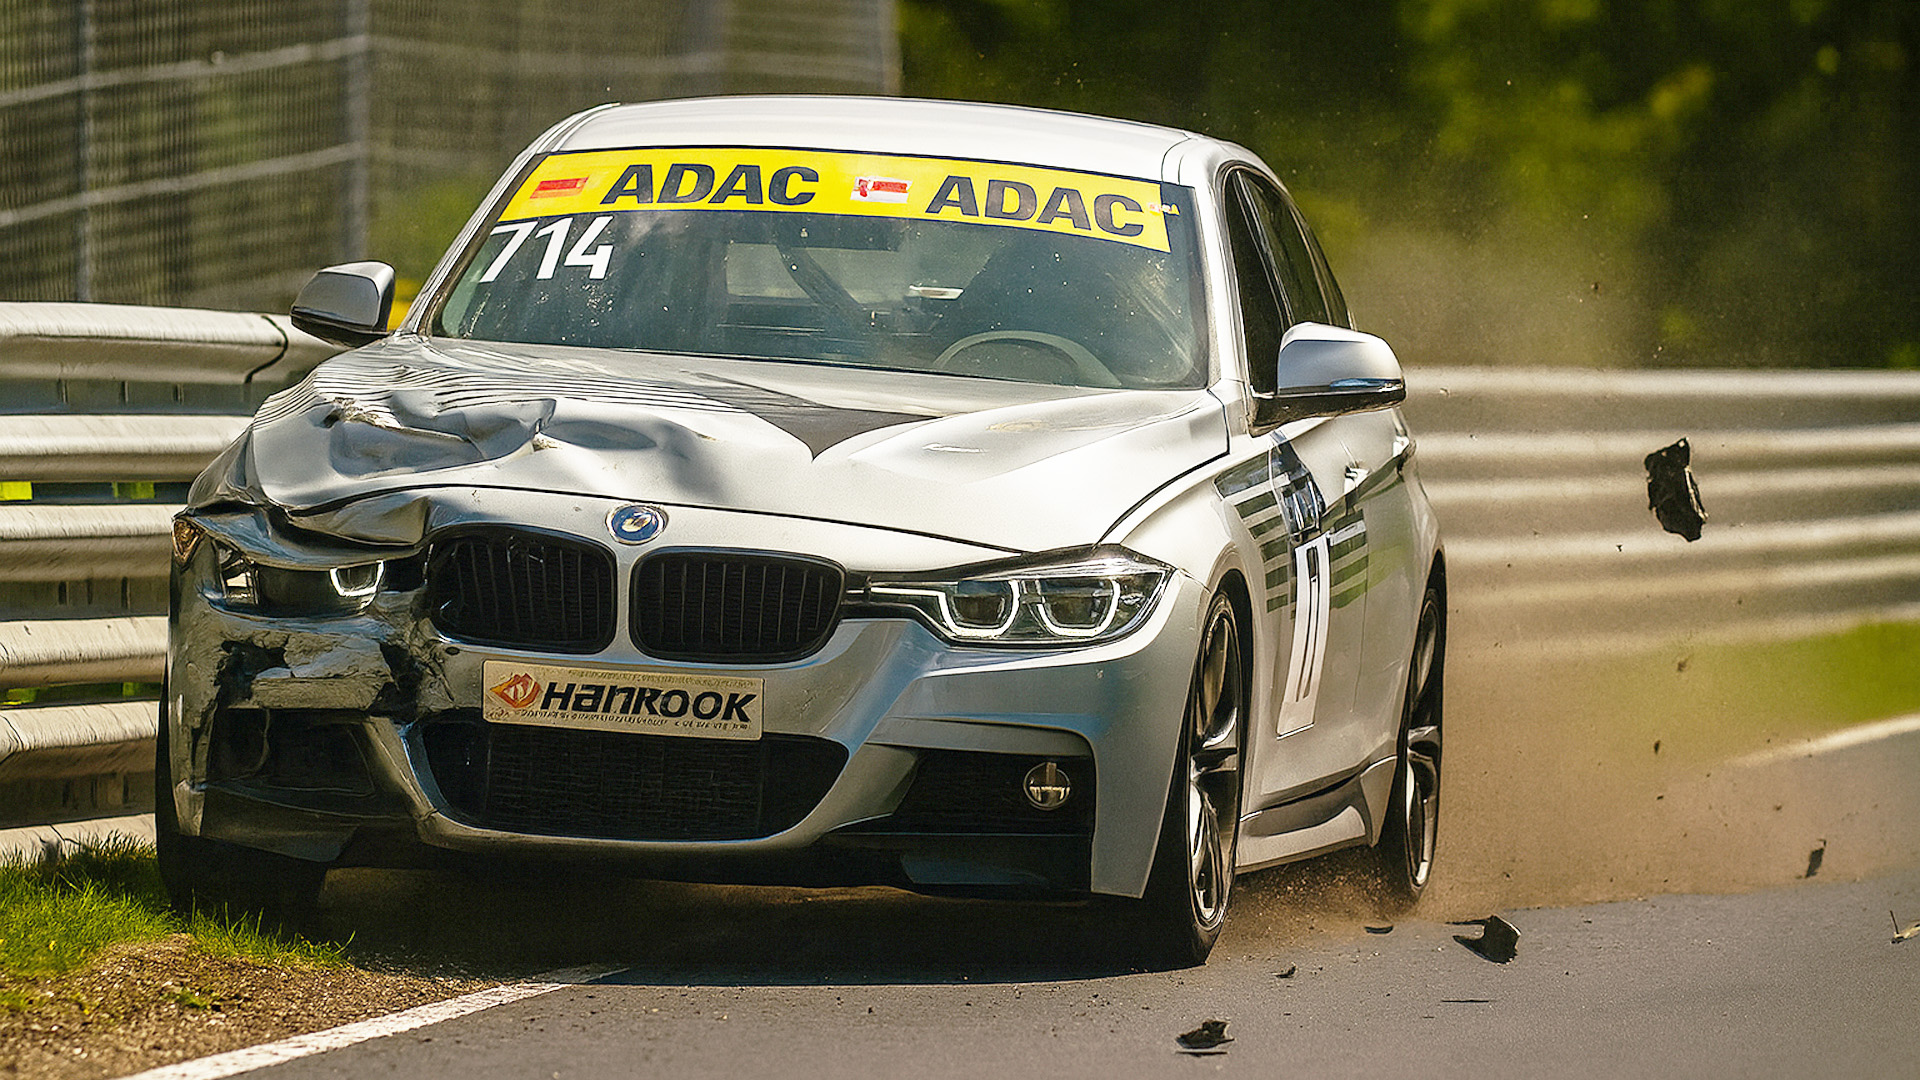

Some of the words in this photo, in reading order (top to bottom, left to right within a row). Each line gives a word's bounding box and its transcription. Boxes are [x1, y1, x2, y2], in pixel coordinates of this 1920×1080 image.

[600, 163, 820, 205] ADAC
[925, 175, 1145, 237] ADAC
[479, 215, 614, 284] 714
